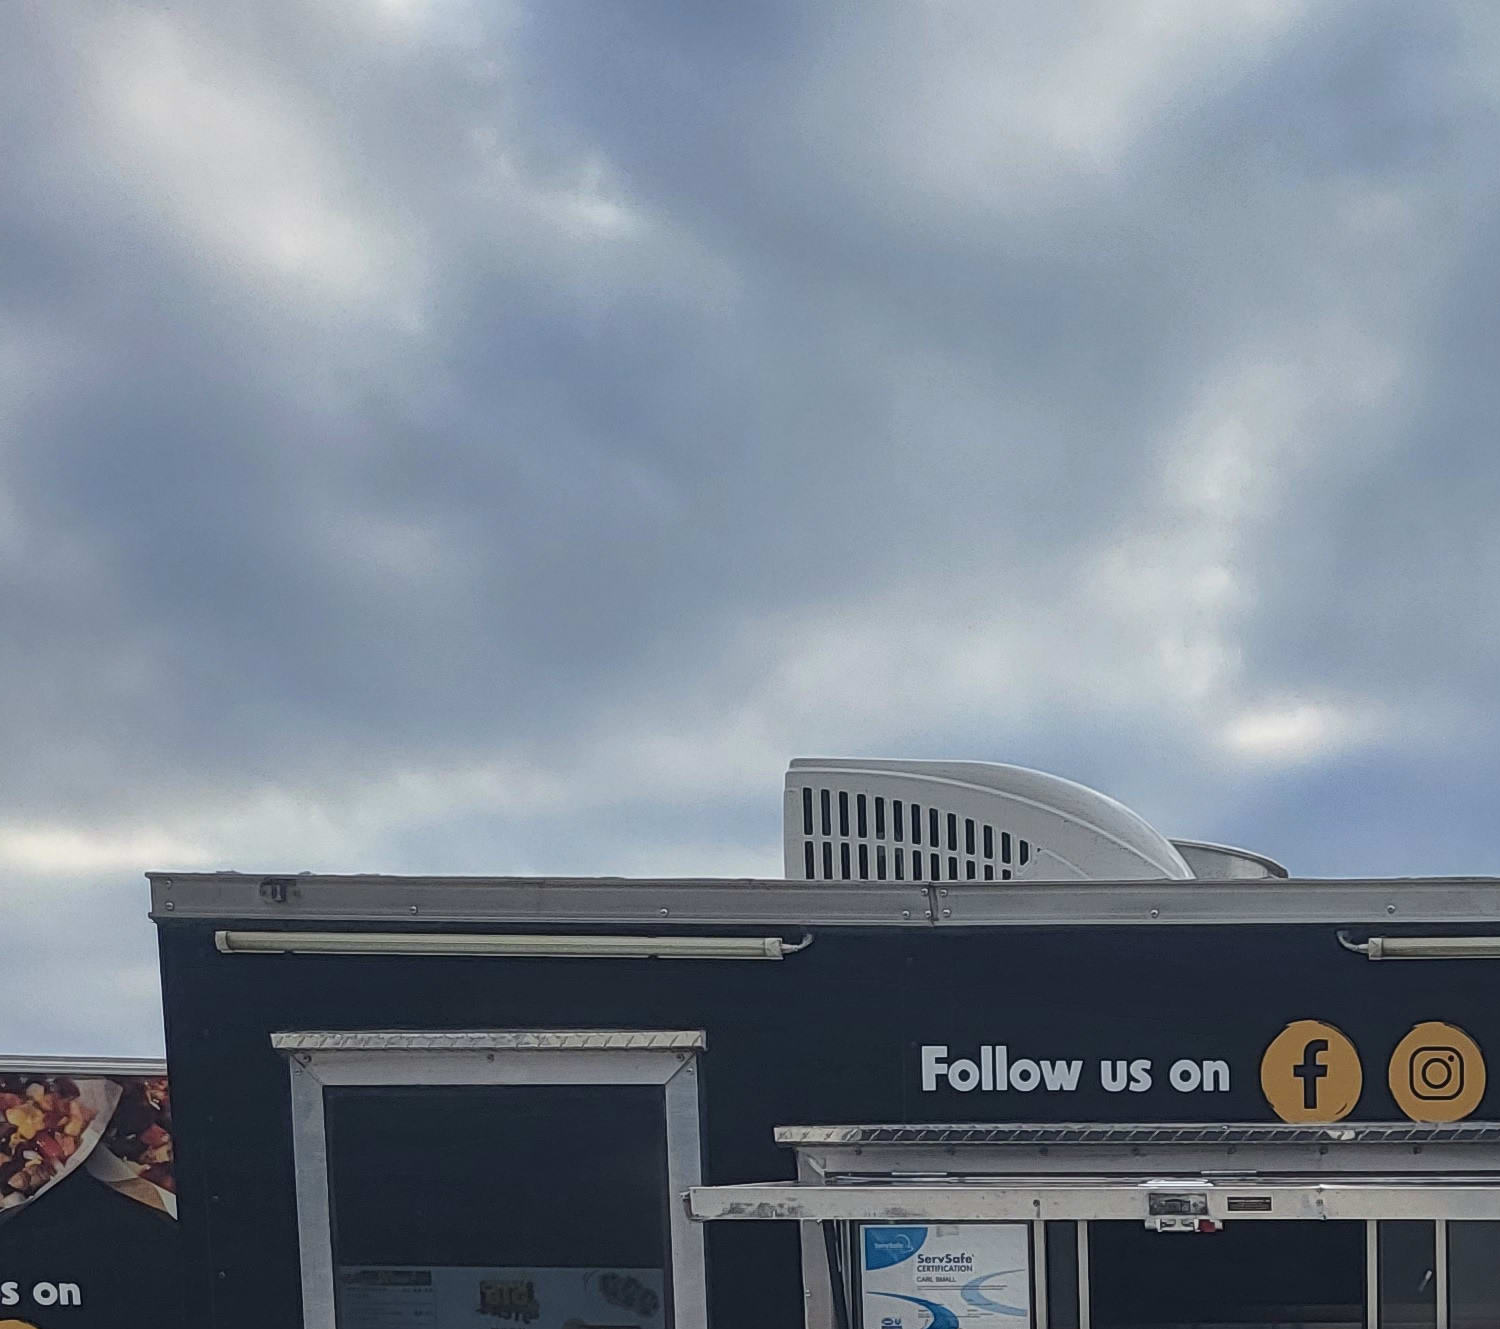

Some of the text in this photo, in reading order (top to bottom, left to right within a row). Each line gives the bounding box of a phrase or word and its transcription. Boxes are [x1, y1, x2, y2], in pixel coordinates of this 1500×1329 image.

[922, 1045, 1231, 1093] Follow us on
[917, 1253, 972, 1264] ServSafe
[917, 1264, 973, 1273] CERTIFICATION
[33, 1281, 81, 1305] on
